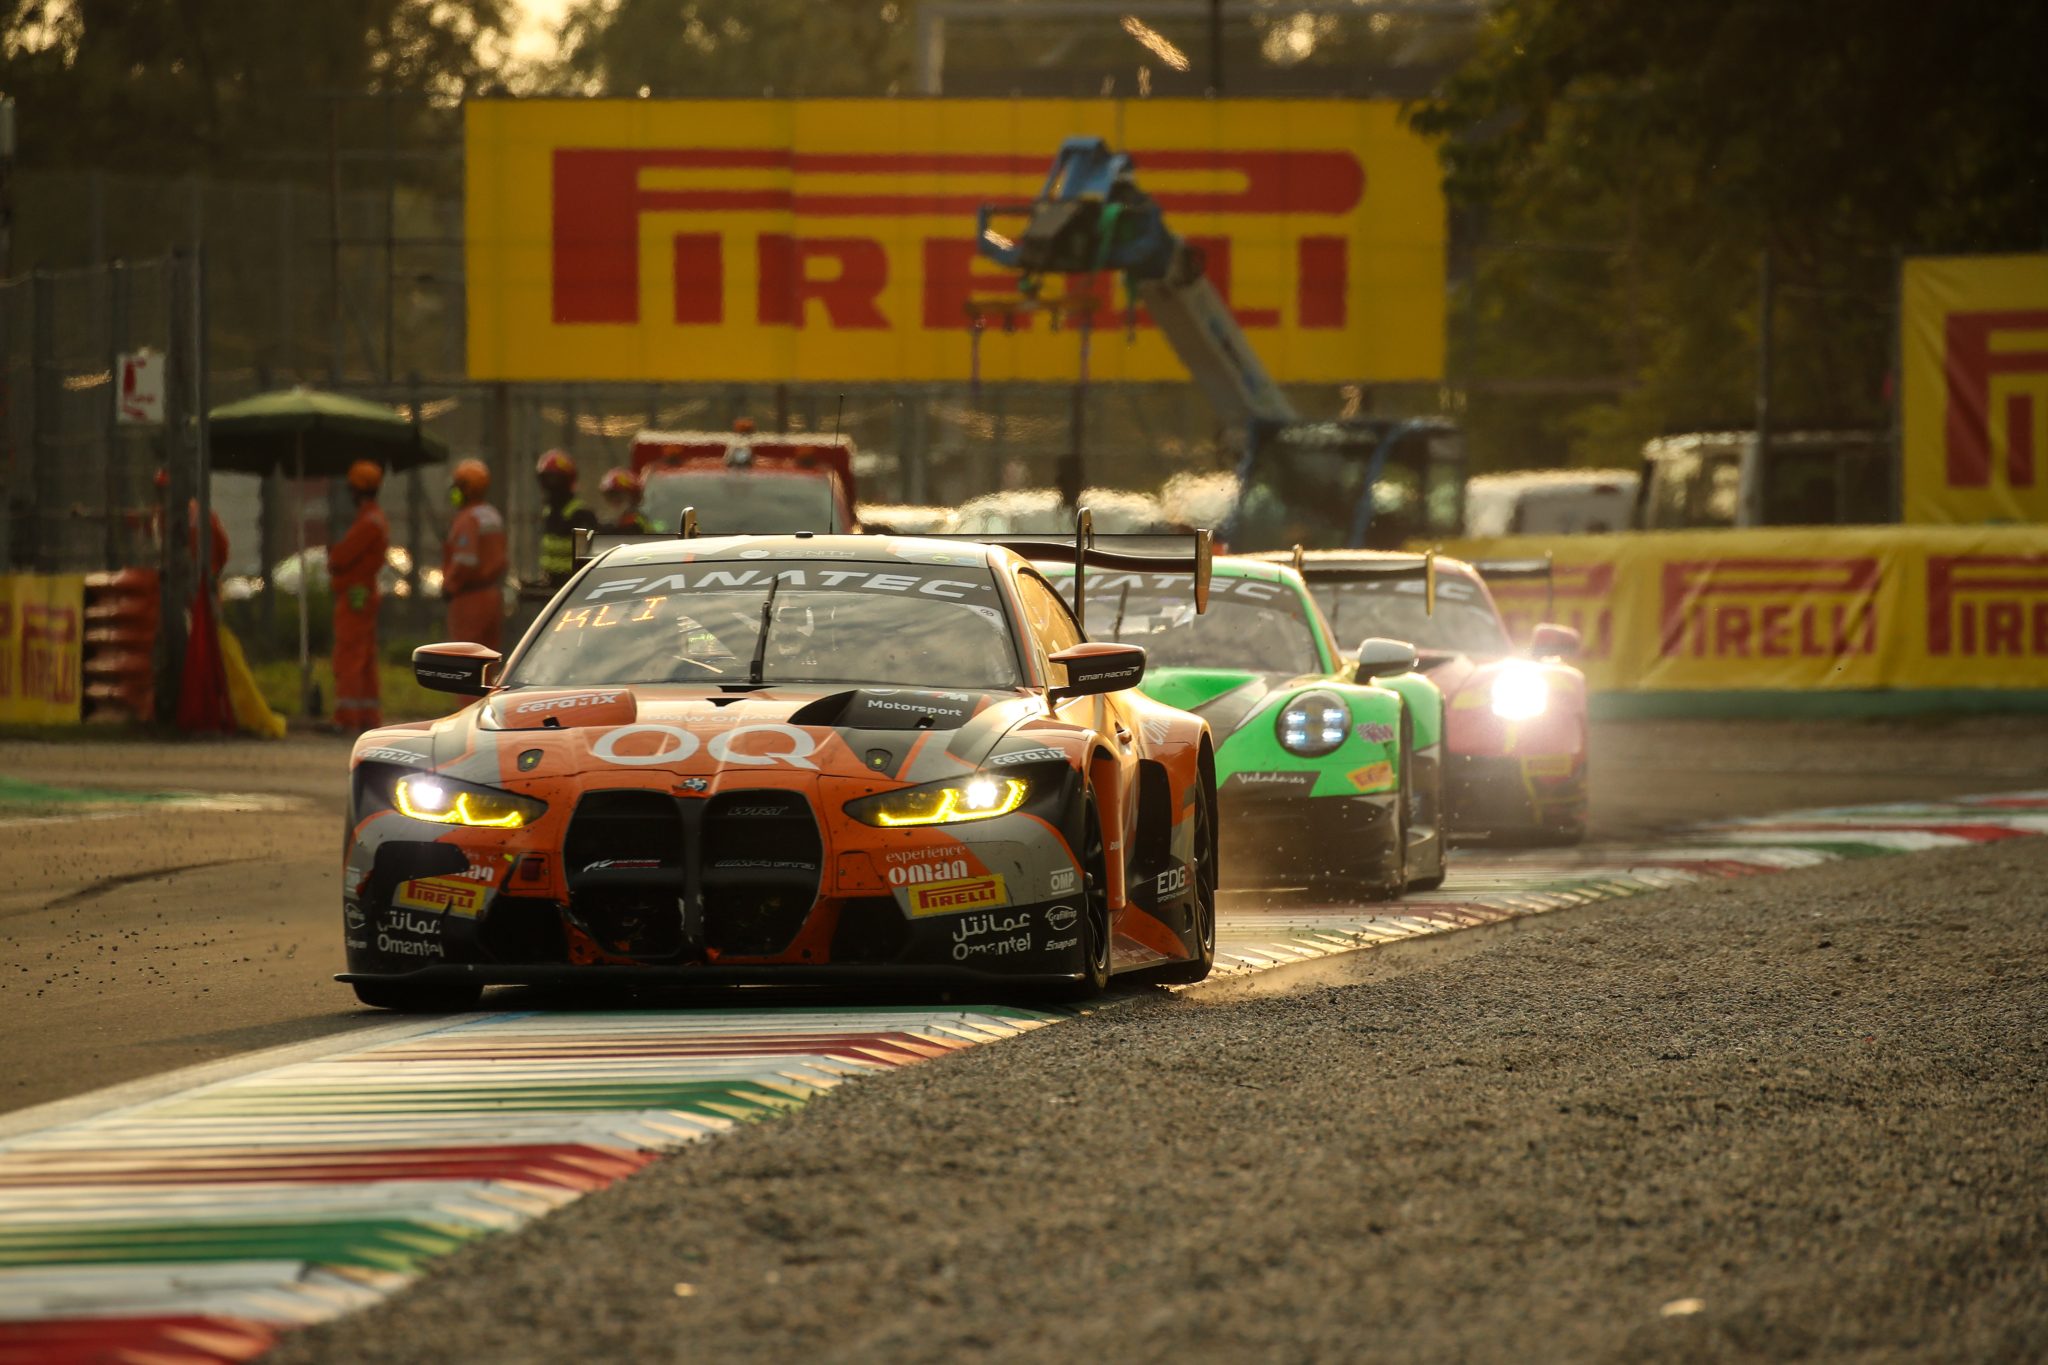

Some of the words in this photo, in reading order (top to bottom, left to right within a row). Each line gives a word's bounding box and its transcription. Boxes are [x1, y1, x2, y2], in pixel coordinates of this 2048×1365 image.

[585, 569, 978, 600] FANATEC
[1661, 557, 1878, 658] PIRELLI
[867, 700, 963, 717] Motorsport
[593, 723, 821, 771] OQ
[886, 846, 966, 864] experience
[888, 860, 968, 885] oman
[1051, 873, 1075, 890] OMP
[406, 881, 476, 909] PIRELLI
[919, 880, 996, 910] PIRELLI
